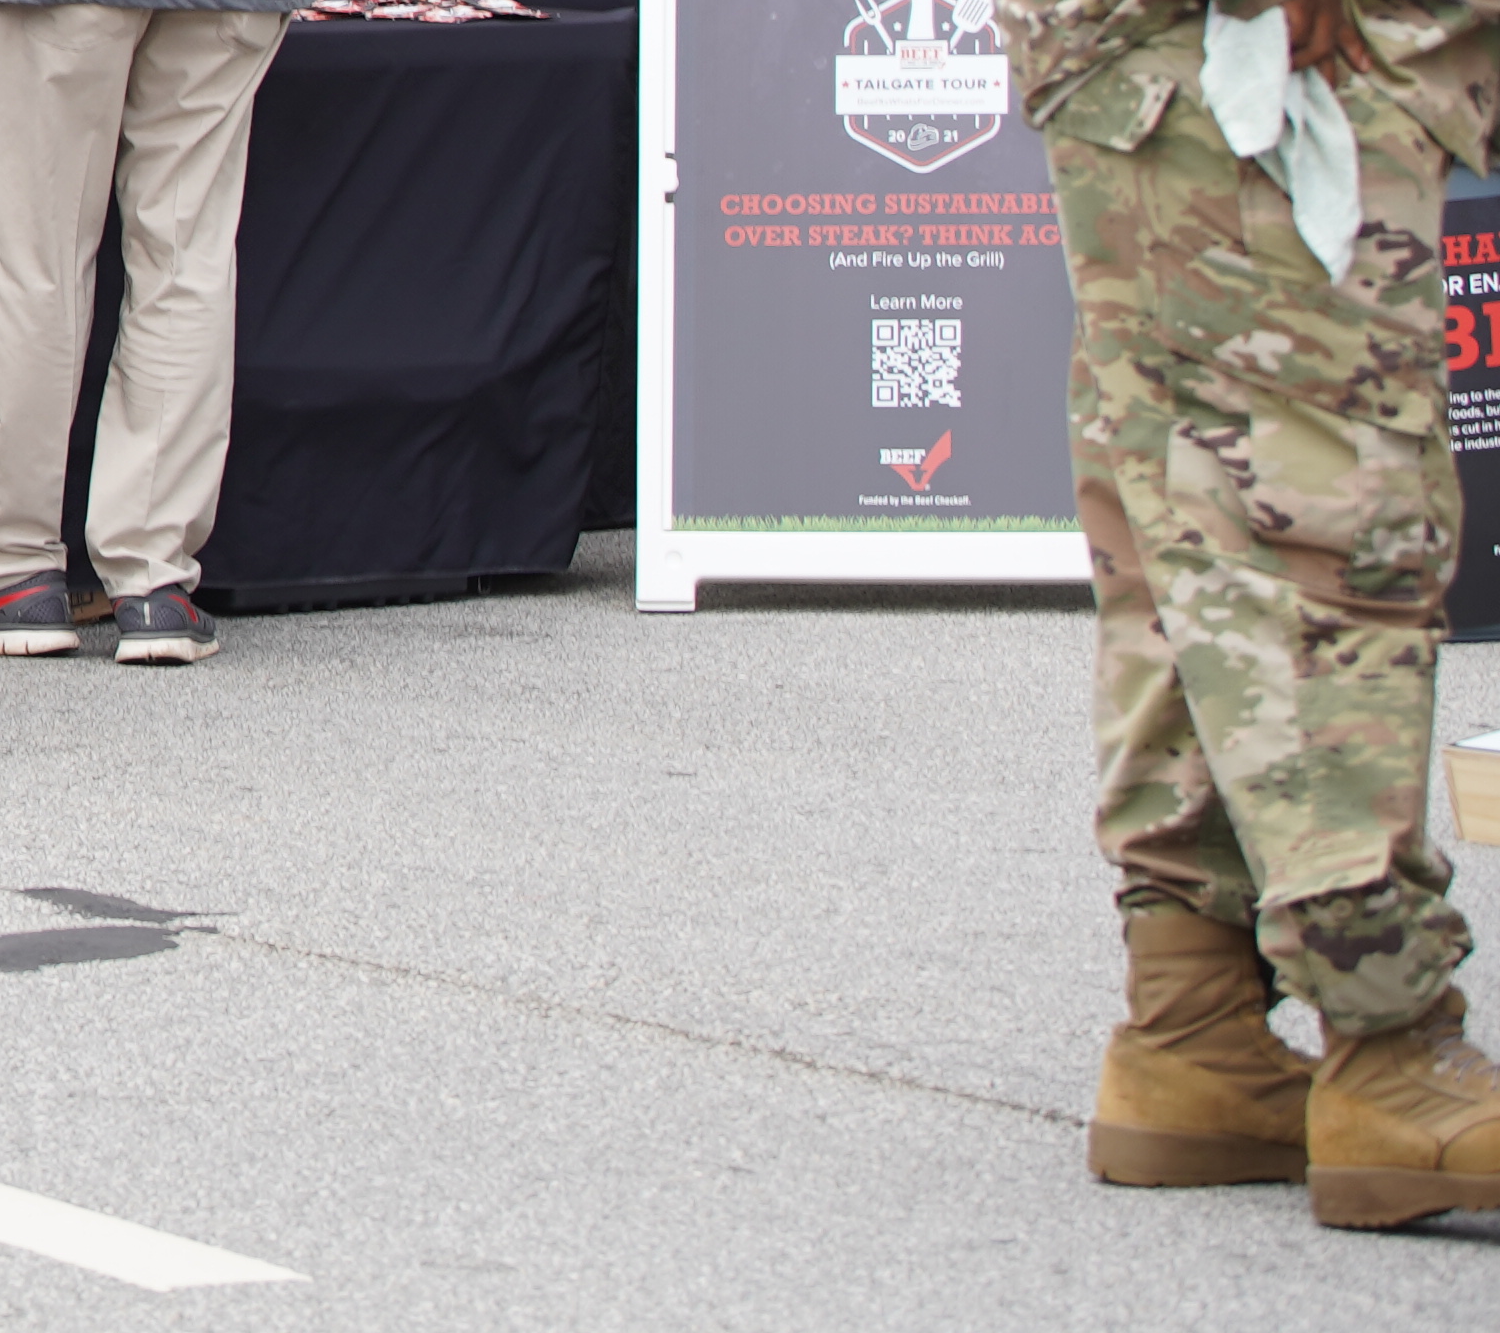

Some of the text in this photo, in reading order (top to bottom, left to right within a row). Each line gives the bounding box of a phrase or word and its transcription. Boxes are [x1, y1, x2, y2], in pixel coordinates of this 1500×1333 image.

[855, 78, 987, 91] TAILGATE TOUR
[720, 193, 877, 216] CHOOSING
[724, 224, 1014, 247] OVER STEAK? THINK
[829, 250, 1005, 271] (And Fire Up the Grill)
[870, 293, 964, 310] Learn More
[879, 448, 926, 465] BEEF
